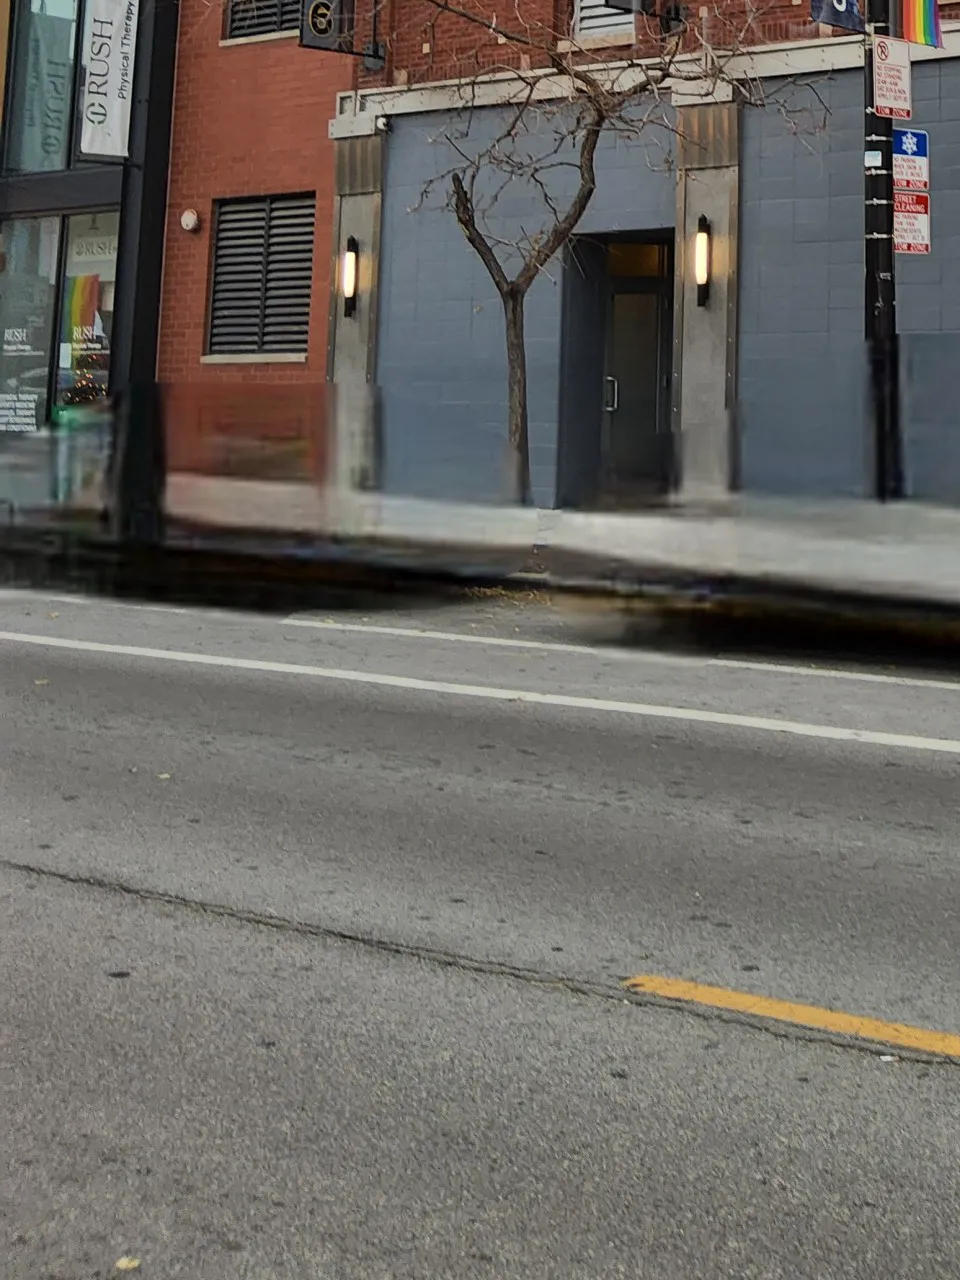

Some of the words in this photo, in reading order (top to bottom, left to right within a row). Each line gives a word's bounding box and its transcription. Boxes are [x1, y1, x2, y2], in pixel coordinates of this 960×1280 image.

[120, 0, 136, 48] Therapy
[87, 17, 113, 98] RUSH
[117, 52, 131, 100] Physical
[894, 193, 917, 204] STREET
[894, 202, 926, 213] CLEANING
